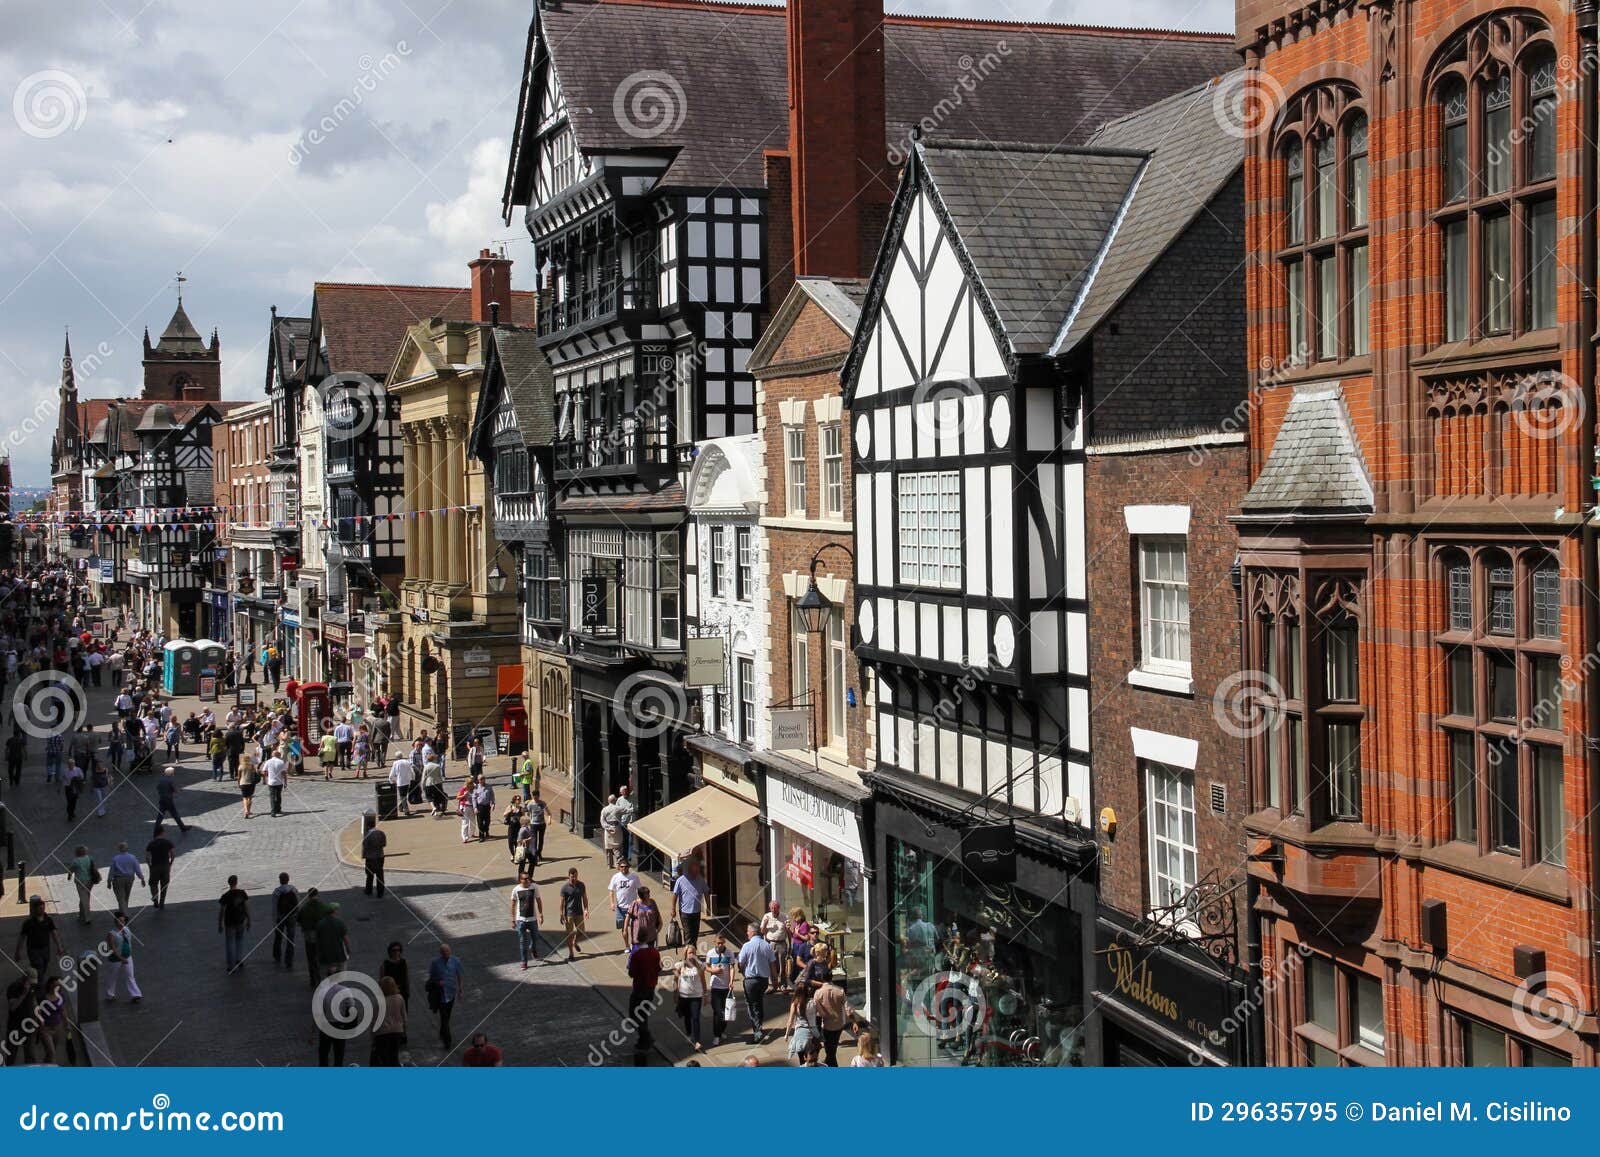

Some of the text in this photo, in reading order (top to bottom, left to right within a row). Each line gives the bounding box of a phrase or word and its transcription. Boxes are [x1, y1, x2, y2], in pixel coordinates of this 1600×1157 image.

[586, 583, 598, 621] next
[782, 777, 809, 812] Russell
[792, 843, 812, 872] SALE
[1107, 943, 1178, 1020] Waltons
